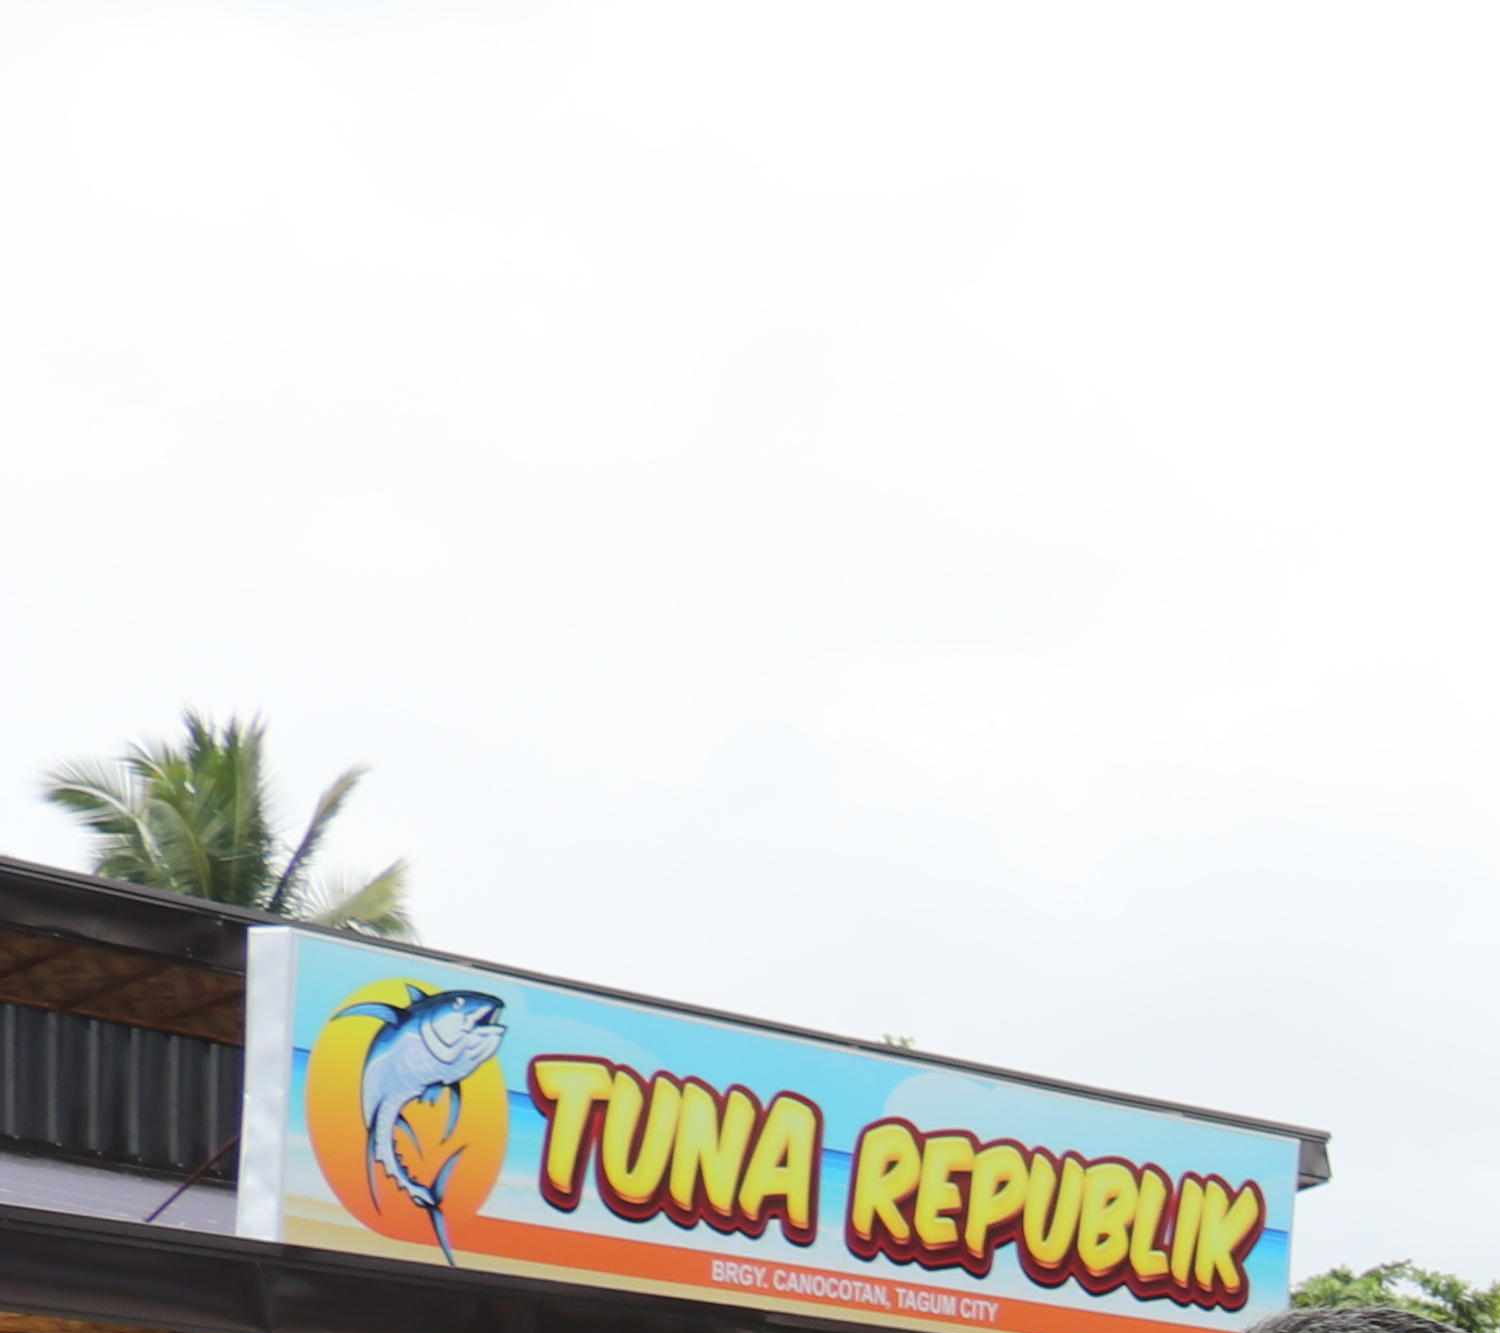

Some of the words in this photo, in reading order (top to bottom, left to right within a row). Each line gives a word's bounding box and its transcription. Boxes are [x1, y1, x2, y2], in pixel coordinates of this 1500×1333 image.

[530, 1056, 820, 1238] TUNA
[848, 1120, 1263, 1302] REPUBLIK
[711, 1259, 768, 1288] BRGY.
[773, 1268, 891, 1309] CANOCOTAN,
[896, 1287, 955, 1317] TAGUM
[960, 1298, 998, 1322] CITY
